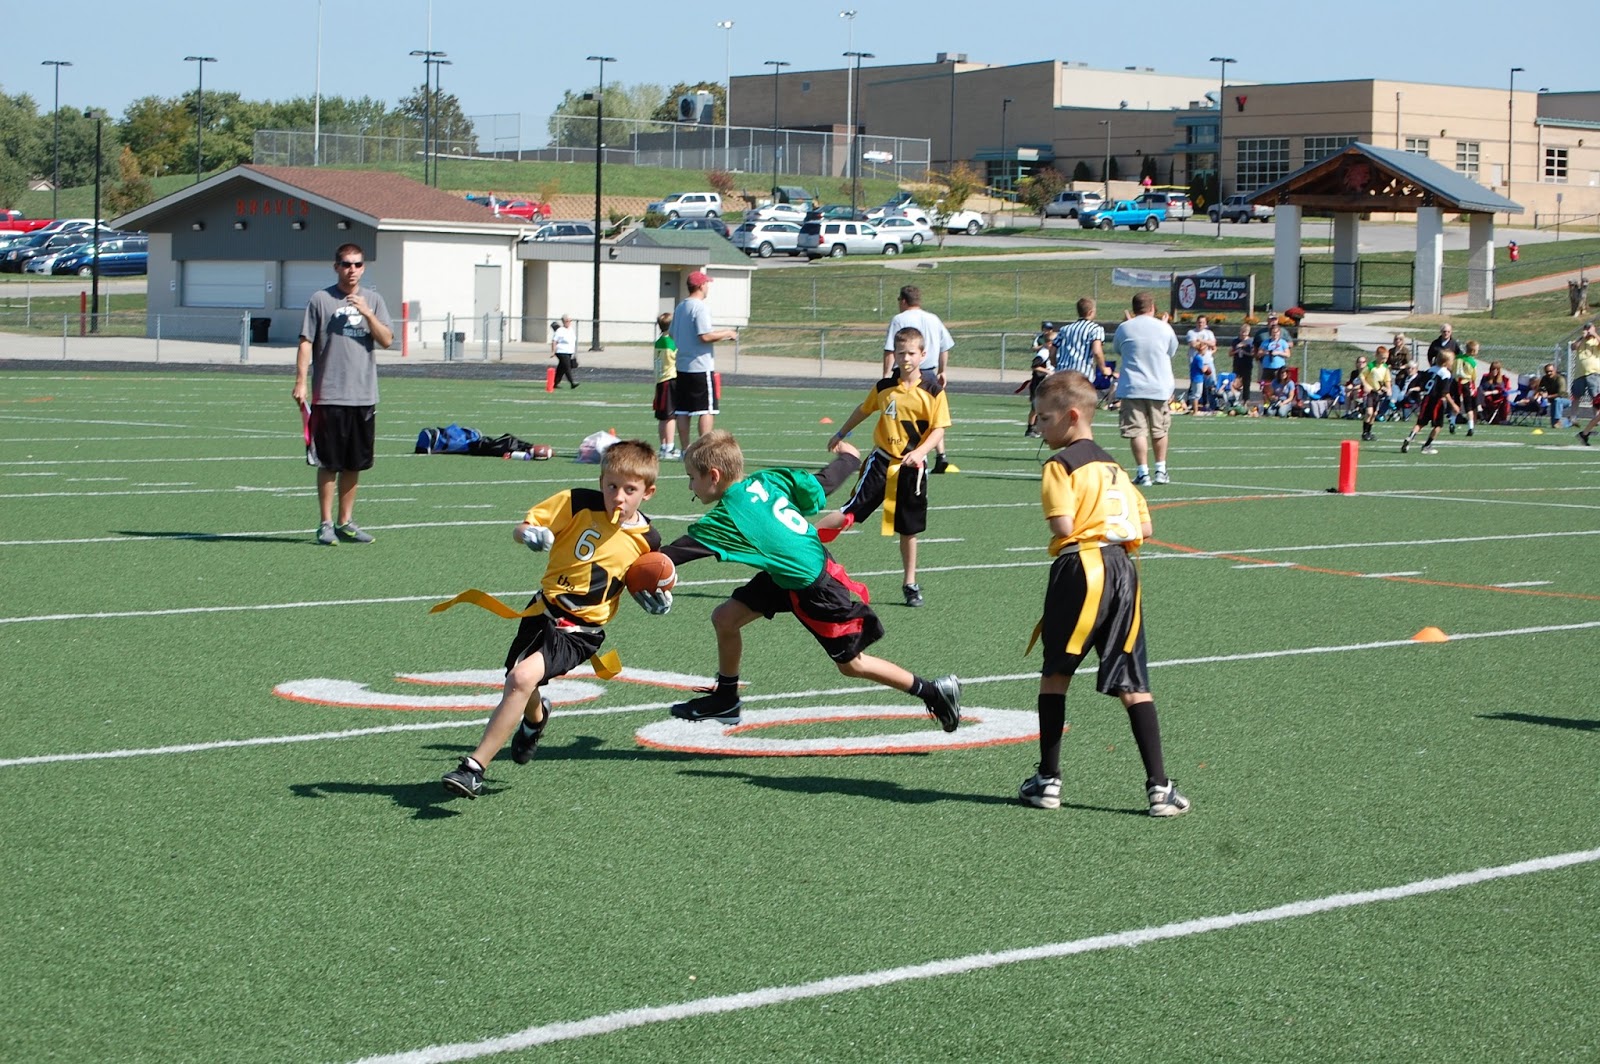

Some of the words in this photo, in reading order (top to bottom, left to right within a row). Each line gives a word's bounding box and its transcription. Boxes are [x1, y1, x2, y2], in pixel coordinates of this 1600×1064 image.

[236, 198, 309, 216] BRAVES
[1200, 279, 1220, 289] David
[1221, 280, 1246, 290] Jaynes
[1207, 291, 1239, 300] FIELD
[885, 400, 898, 420] 4
[887, 436, 903, 446] the
[773, 496, 808, 535] 6
[574, 529, 601, 561] 6
[557, 574, 576, 592] the
